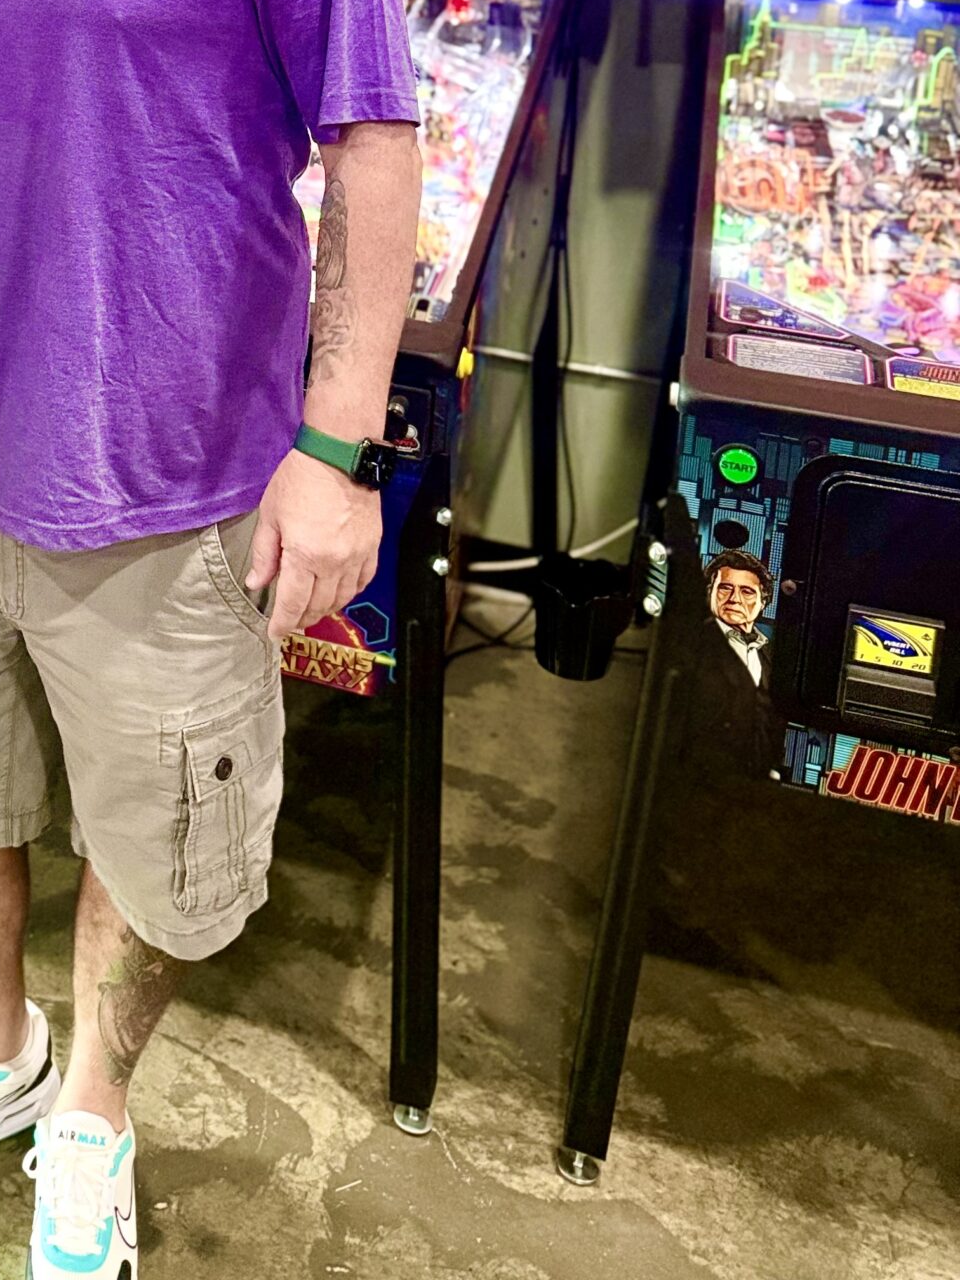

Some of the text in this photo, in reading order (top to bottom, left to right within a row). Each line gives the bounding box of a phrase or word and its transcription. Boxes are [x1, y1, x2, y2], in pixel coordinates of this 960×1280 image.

[720, 460, 756, 474] START
[883, 639, 911, 650] INSERT
[889, 647, 906, 656] BILL
[891, 659, 904, 667] 10
[911, 663, 927, 671] 20
[826, 745, 957, 818] JOHN
